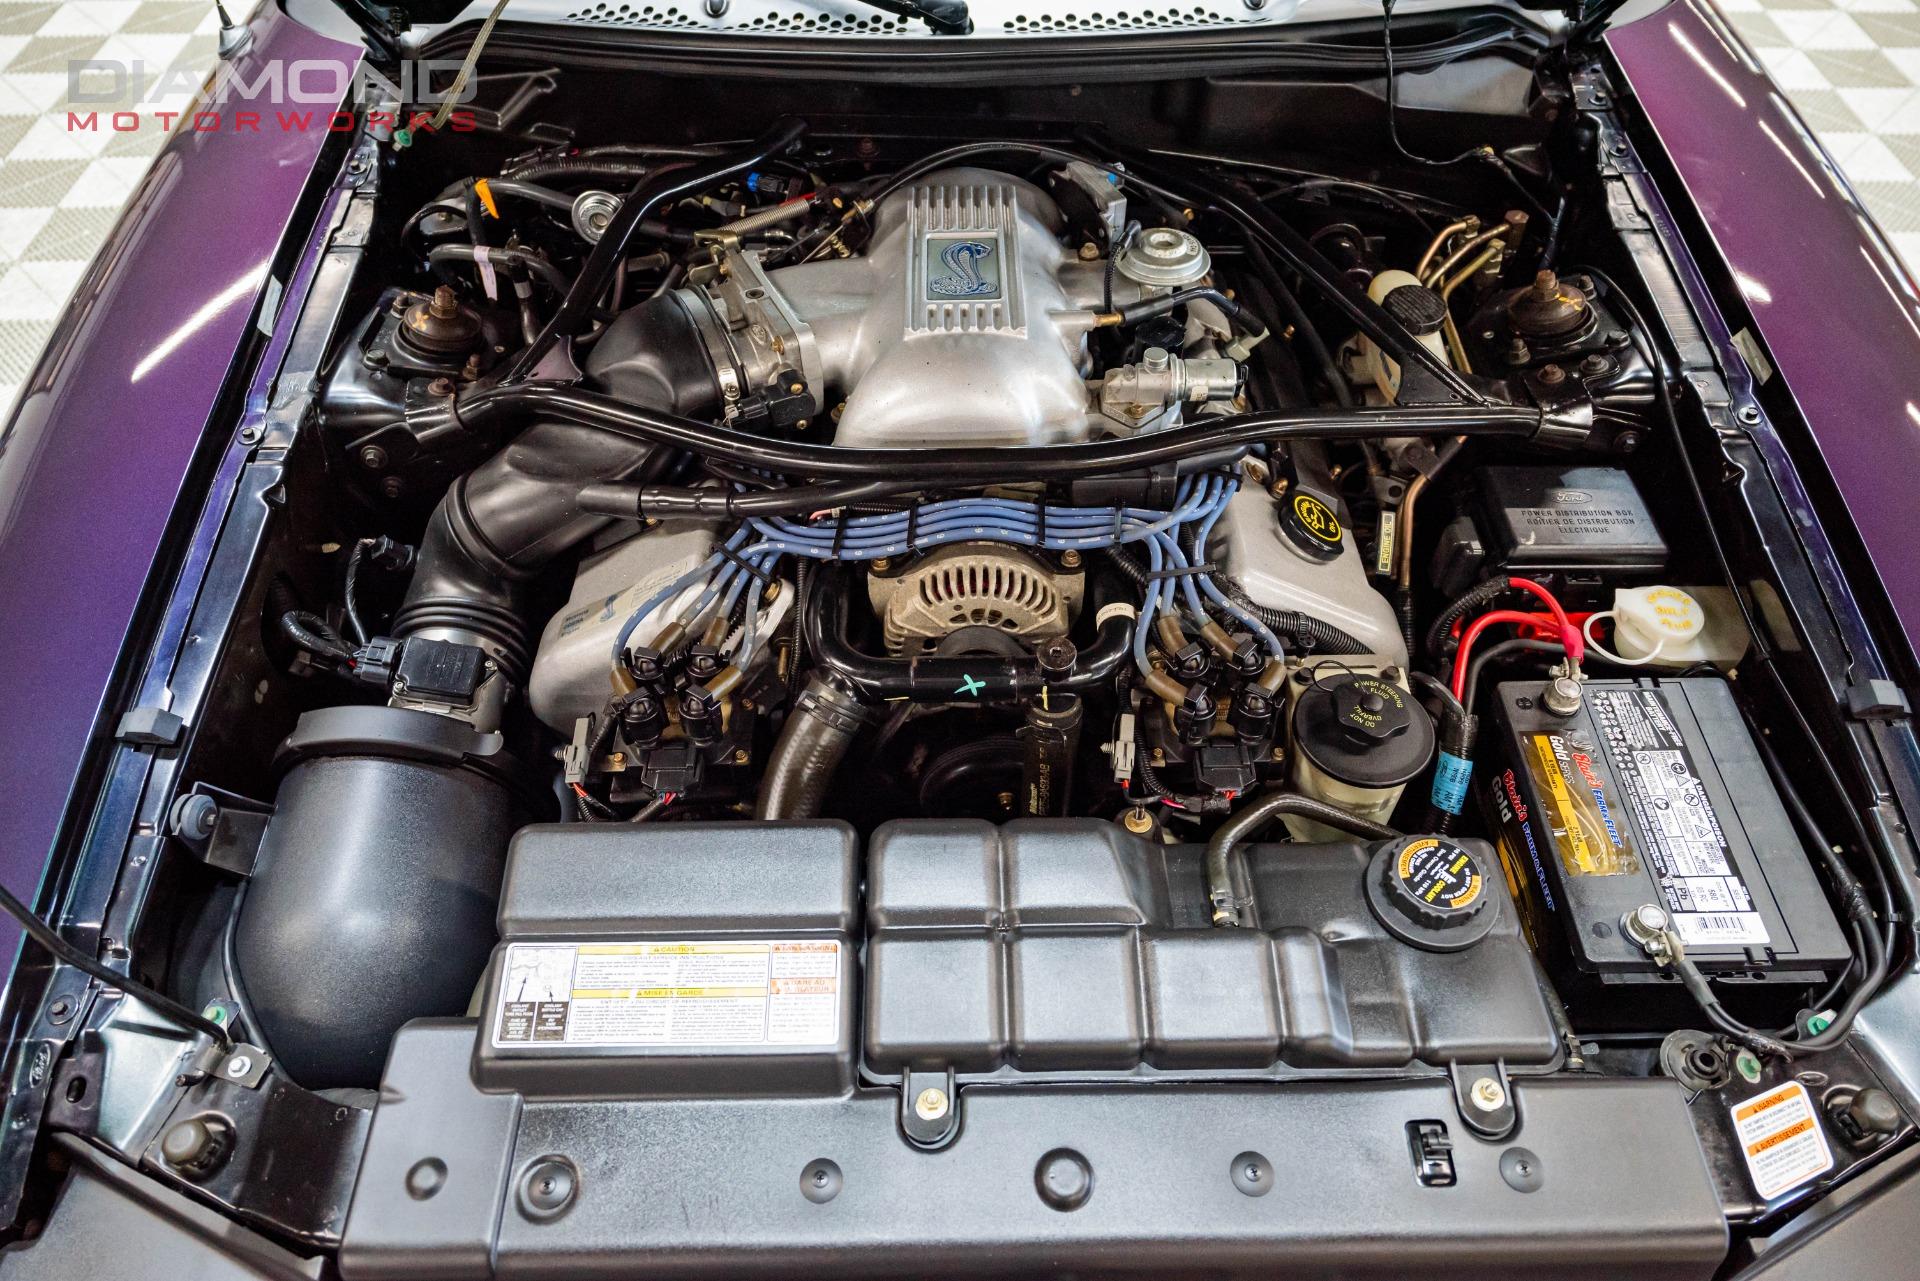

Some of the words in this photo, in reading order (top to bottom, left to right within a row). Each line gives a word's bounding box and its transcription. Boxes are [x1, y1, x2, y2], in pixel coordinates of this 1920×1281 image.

[1557, 492, 1585, 502] Ford
[1383, 521, 1391, 533] OIL
[1381, 535, 1391, 563] ENGINE
[1371, 688, 1389, 700] FLUID
[1381, 684, 1403, 708] STEERING
[1350, 713, 1363, 724] NOT
[1354, 705, 1382, 721] OVERFILL
[1642, 692, 1683, 746] MAINTENANCE-FREE
[1645, 706, 1665, 730] BATTERY
[1550, 735, 1570, 762] Gold
[1492, 775, 1512, 824] Gold
[1503, 768, 1529, 822] Blain's
[1572, 752, 1604, 789] Blain's
[1592, 788, 1606, 812] FARM
[1604, 818, 1623, 848] FLEET
[1695, 784, 1727, 847] DANGER/POISON
[1425, 856, 1439, 870] Owner
[1449, 855, 1469, 874] ENGINE
[1413, 869, 1427, 882] Guide
[1425, 880, 1446, 902] COOLANT
[1677, 887, 1688, 900] Pb
[1759, 1095, 1785, 1110] WARNING
[1760, 1123, 1806, 1148] AVERTISSEMENT
